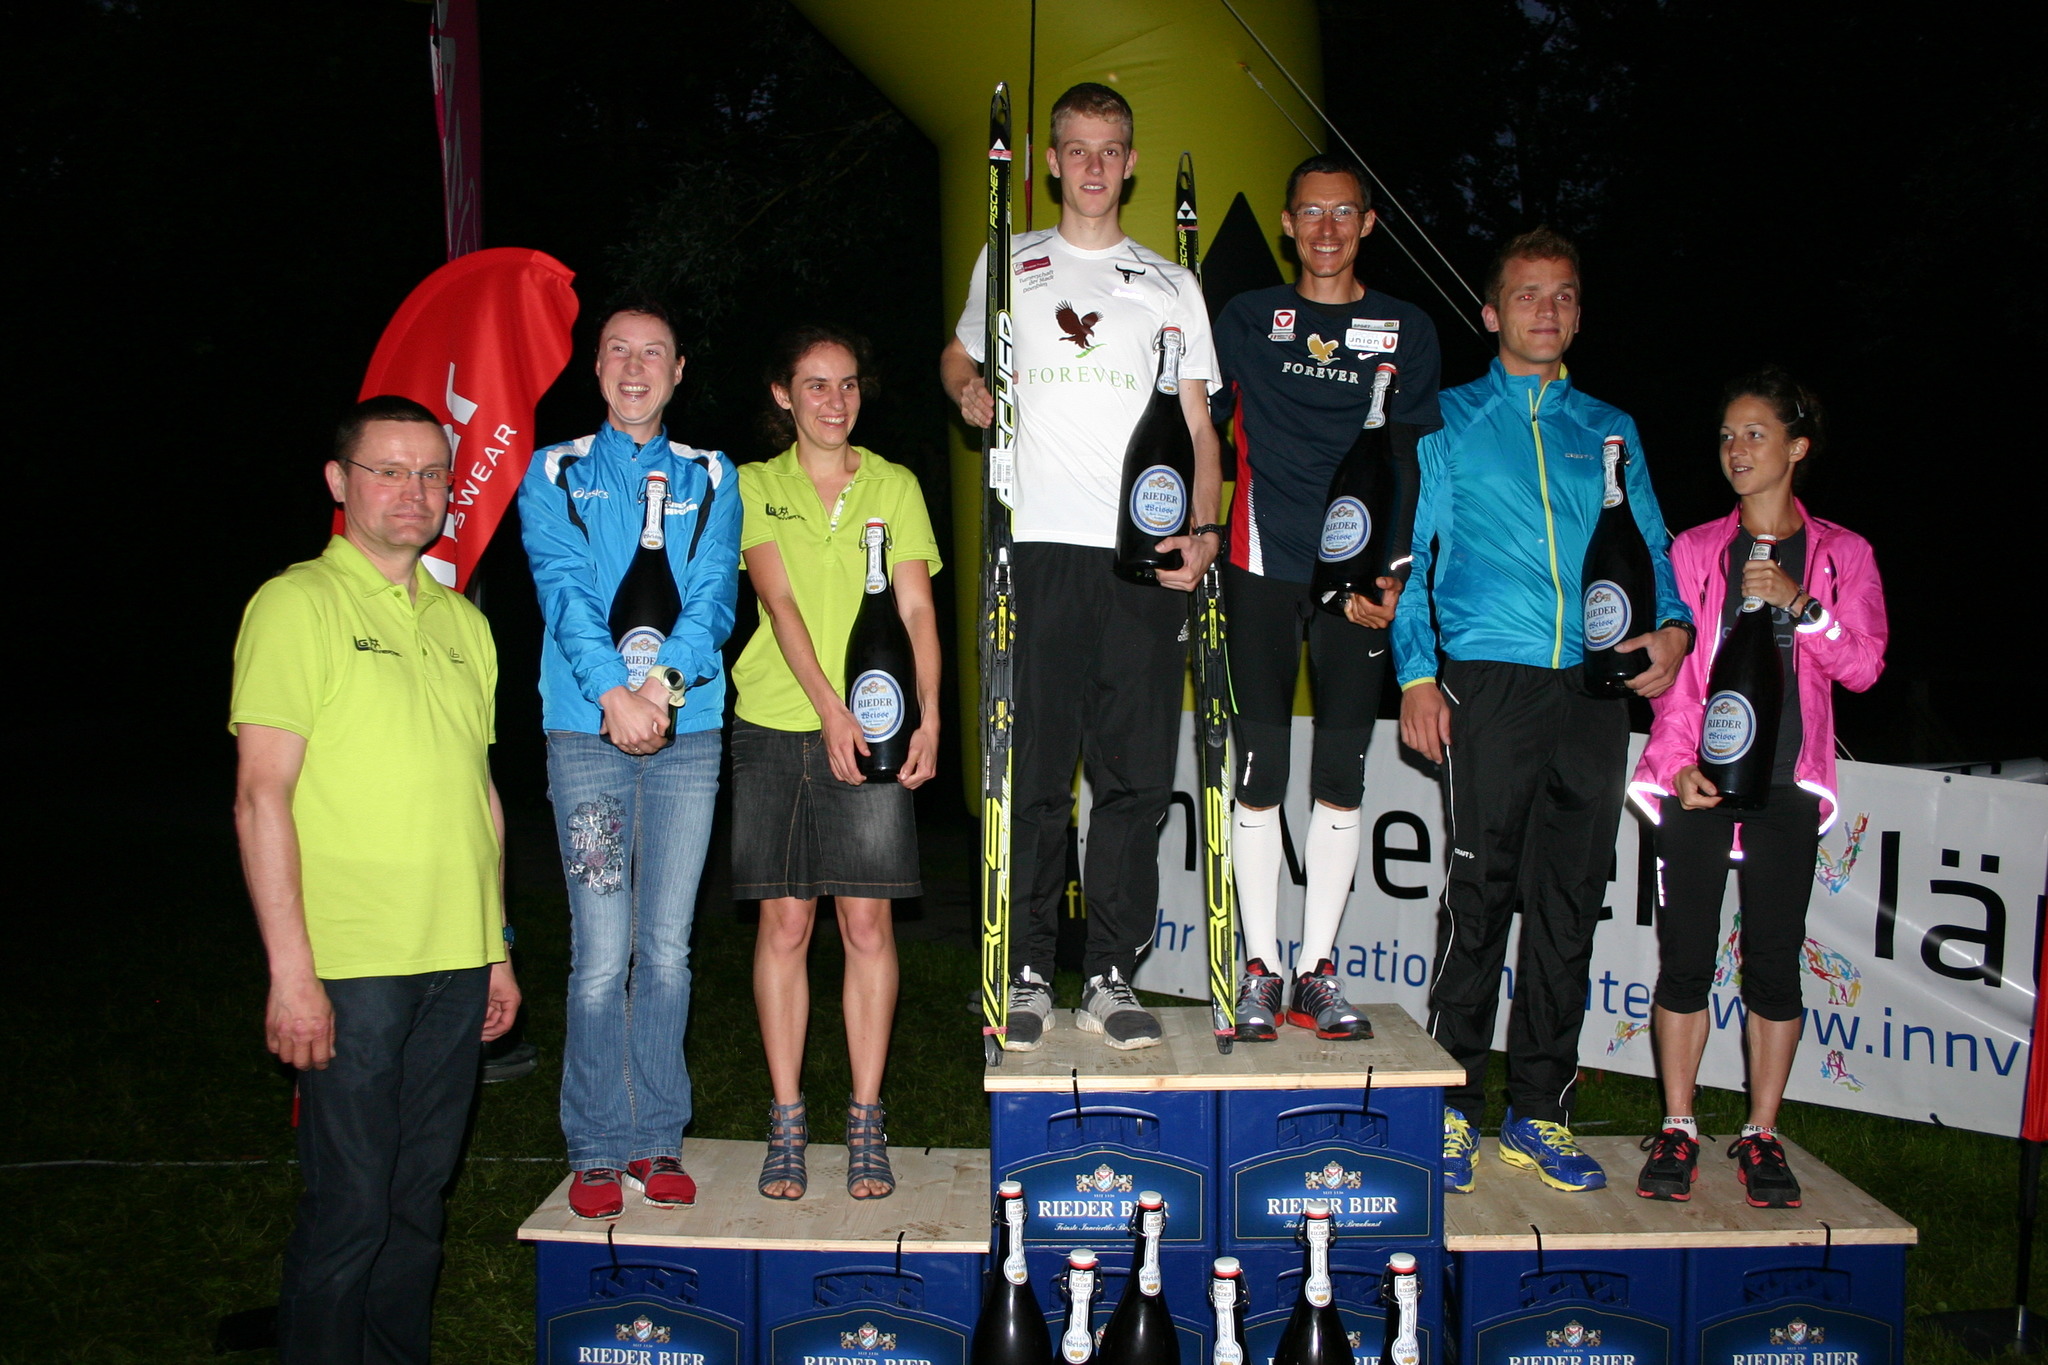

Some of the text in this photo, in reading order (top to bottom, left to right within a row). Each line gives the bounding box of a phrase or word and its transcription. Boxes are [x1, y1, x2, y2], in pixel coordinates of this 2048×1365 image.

[989, 164, 999, 229] FISCHER
[1028, 366, 1137, 391] FOREVER
[1282, 362, 1359, 384] FOREVER
[1142, 491, 1178, 505] RIEDER
[1325, 521, 1358, 533] RIEDER
[1586, 605, 1617, 620] RIEDER
[625, 655, 657, 665] RIEDE
[858, 697, 893, 709] RIEDER
[1708, 719, 1742, 730] RIEDER
[1875, 830, 2046, 992] lä
[1038, 1200, 1114, 1217] RIEDER
[1349, 1196, 1398, 1213] BIER
[579, 1346, 705, 1365] RIEDER BIER
[1812, 1351, 1859, 1365] BIER
